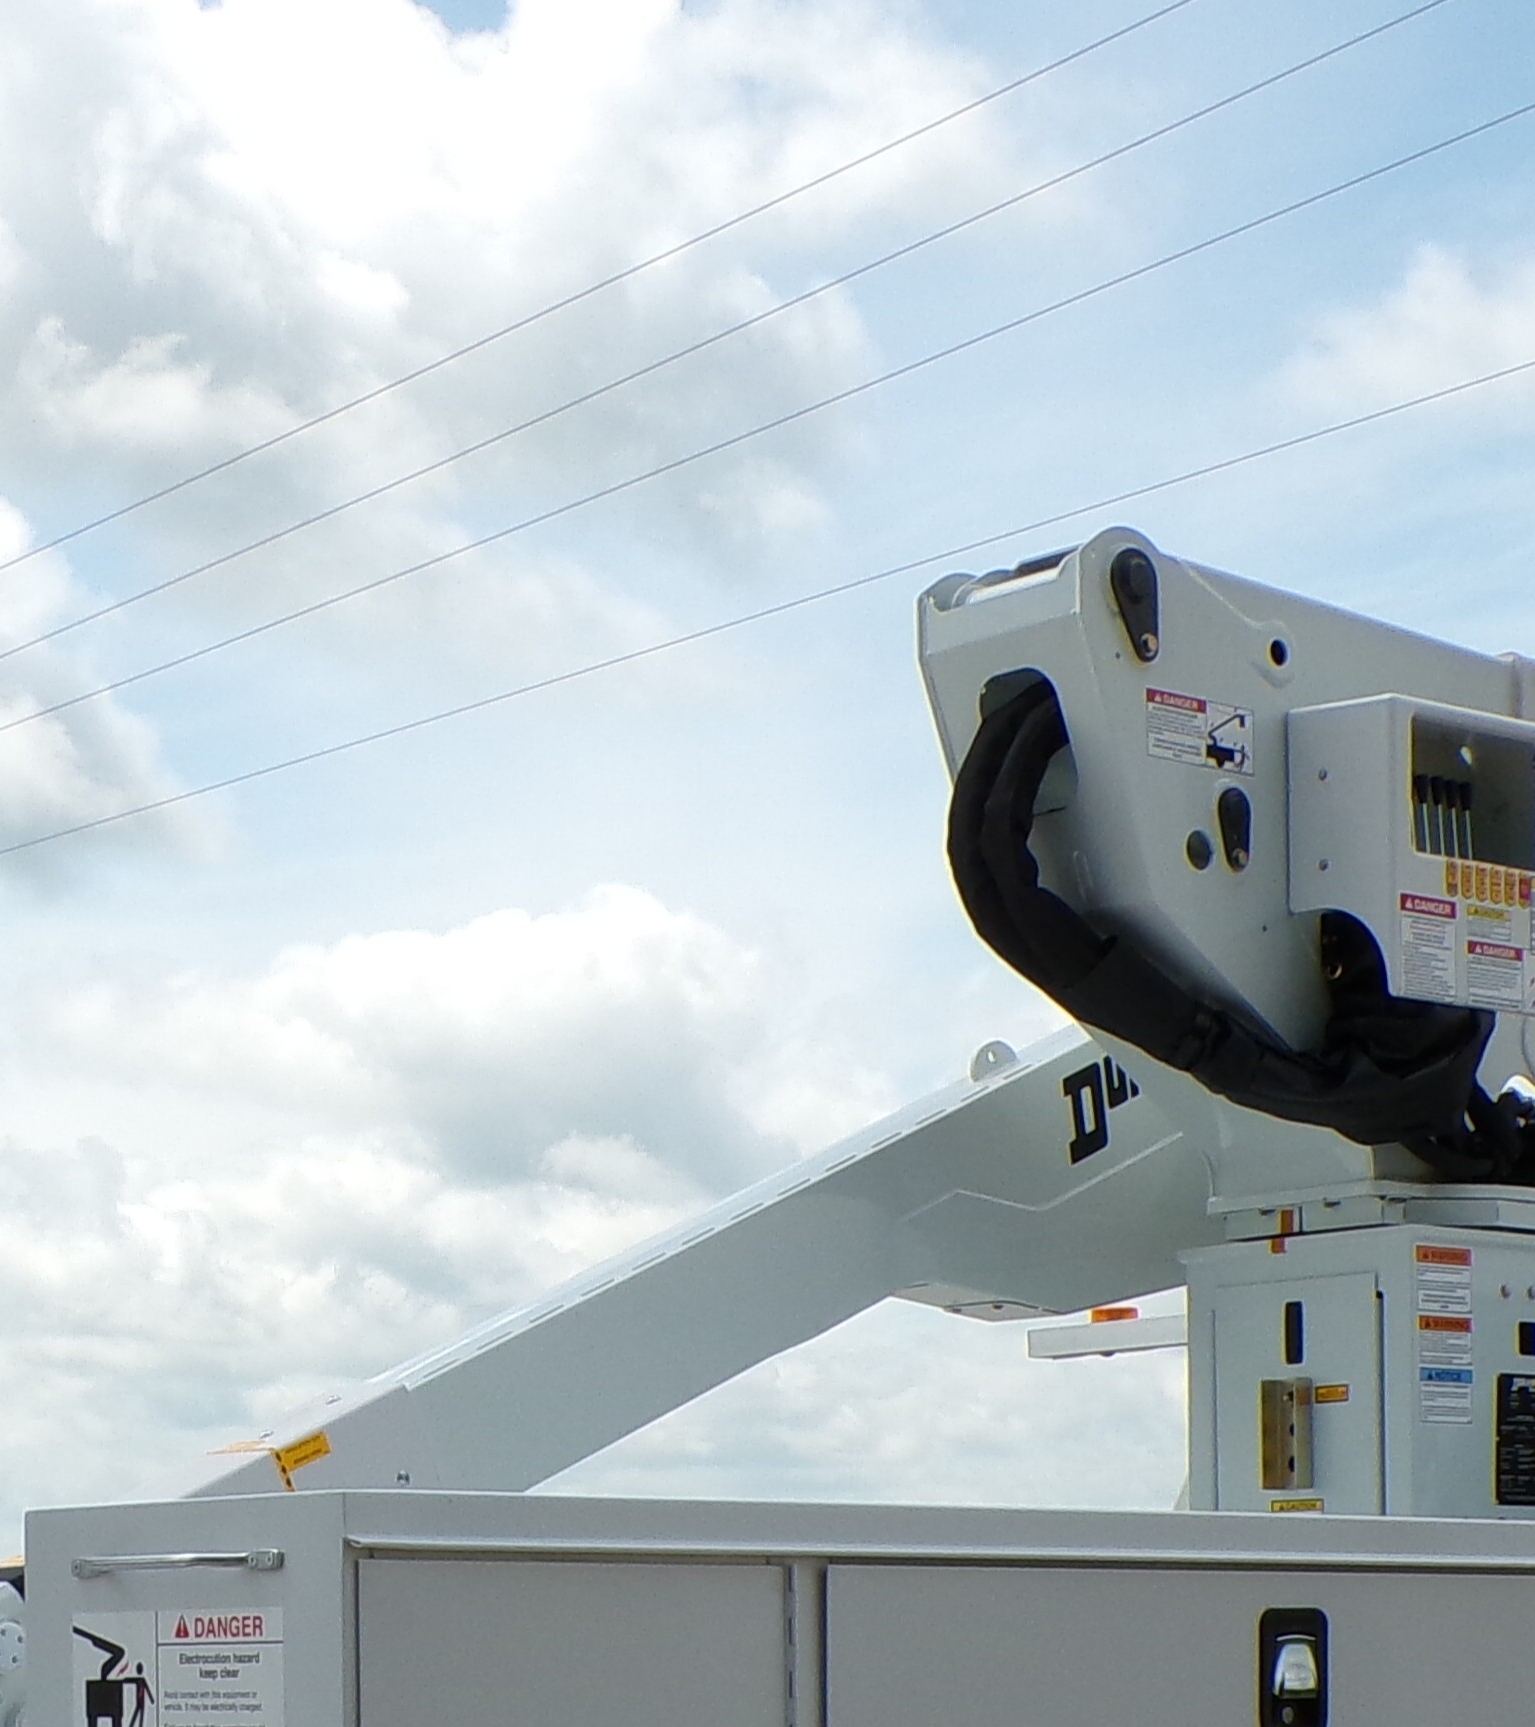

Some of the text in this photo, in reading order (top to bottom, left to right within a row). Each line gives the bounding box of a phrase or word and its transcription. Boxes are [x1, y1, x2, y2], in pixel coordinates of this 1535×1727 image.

[1414, 899, 1452, 915] DANGER
[1483, 944, 1516, 959] DANGER
[1063, 1056, 1140, 1165] DU
[194, 1615, 264, 1638] DANGER
[179, 1651, 260, 1665] Electrocution hazard
[199, 1666, 240, 1680] keep clear
